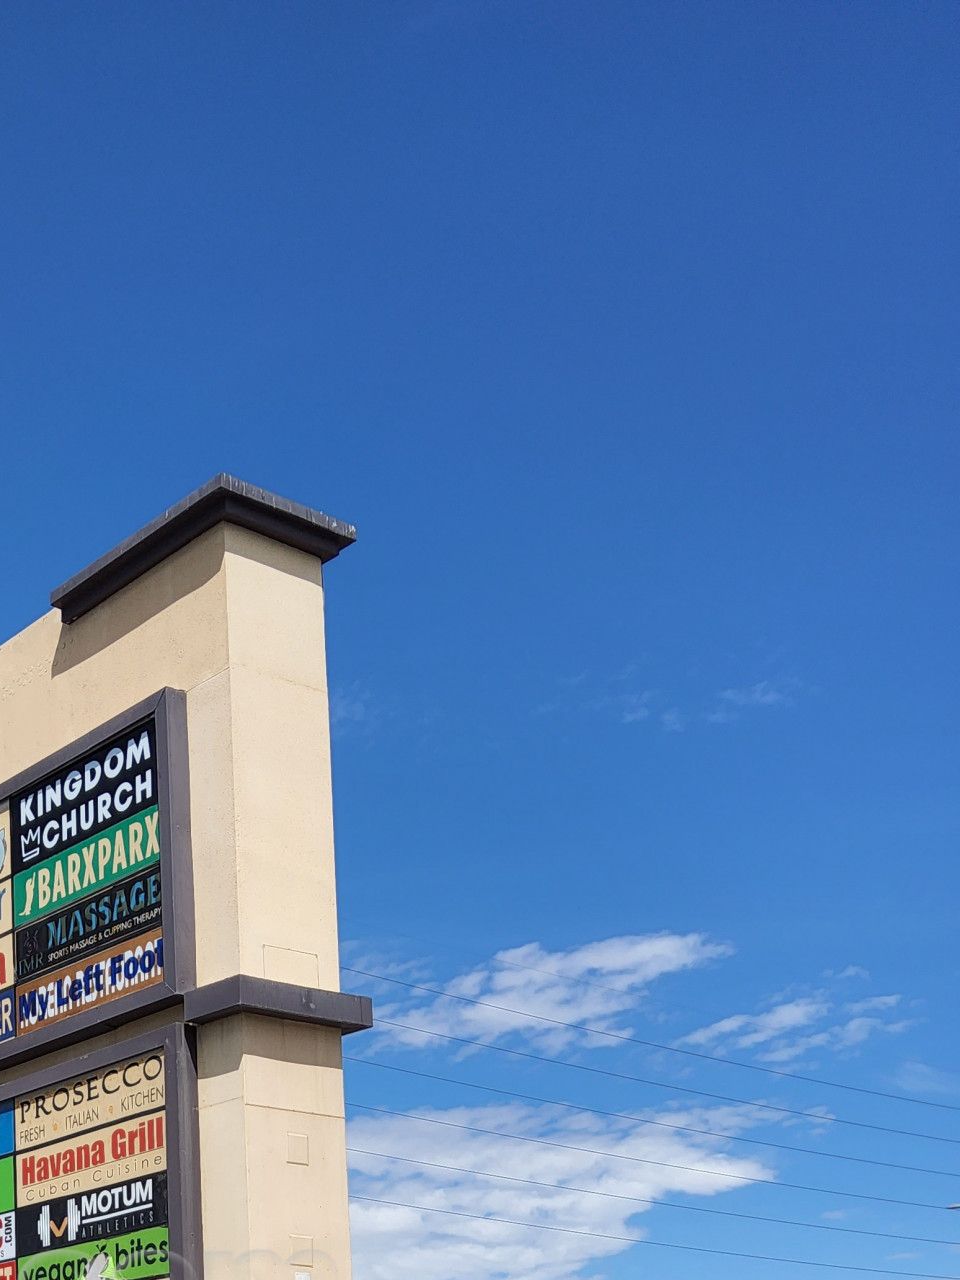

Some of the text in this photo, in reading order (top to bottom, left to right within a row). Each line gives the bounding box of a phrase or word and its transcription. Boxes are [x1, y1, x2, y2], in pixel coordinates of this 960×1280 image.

[20, 731, 150, 825] KINGDOM
[43, 769, 152, 848] CHURCH
[46, 875, 159, 949] MASSAGE
[48, 946, 69, 962] SPORTS
[70, 935, 97, 953] MASSAGE
[104, 920, 132, 937] CUPPING
[133, 907, 161, 927] THERAPY
[19, 989, 49, 1021] My
[56, 965, 105, 1007] Left
[110, 939, 164, 986] Foot
[20, 1055, 162, 1123] PROSECCO
[20, 1085, 164, 1144] FRESH ITALIAN KITCHEN
[22, 1116, 163, 1186] Havana Grill
[26, 1156, 162, 1201] Cuban Cuisine
[81, 1179, 153, 1217] MOTUM
[81, 1213, 154, 1239] ATHLETICS
[115, 1239, 168, 1271] bites
